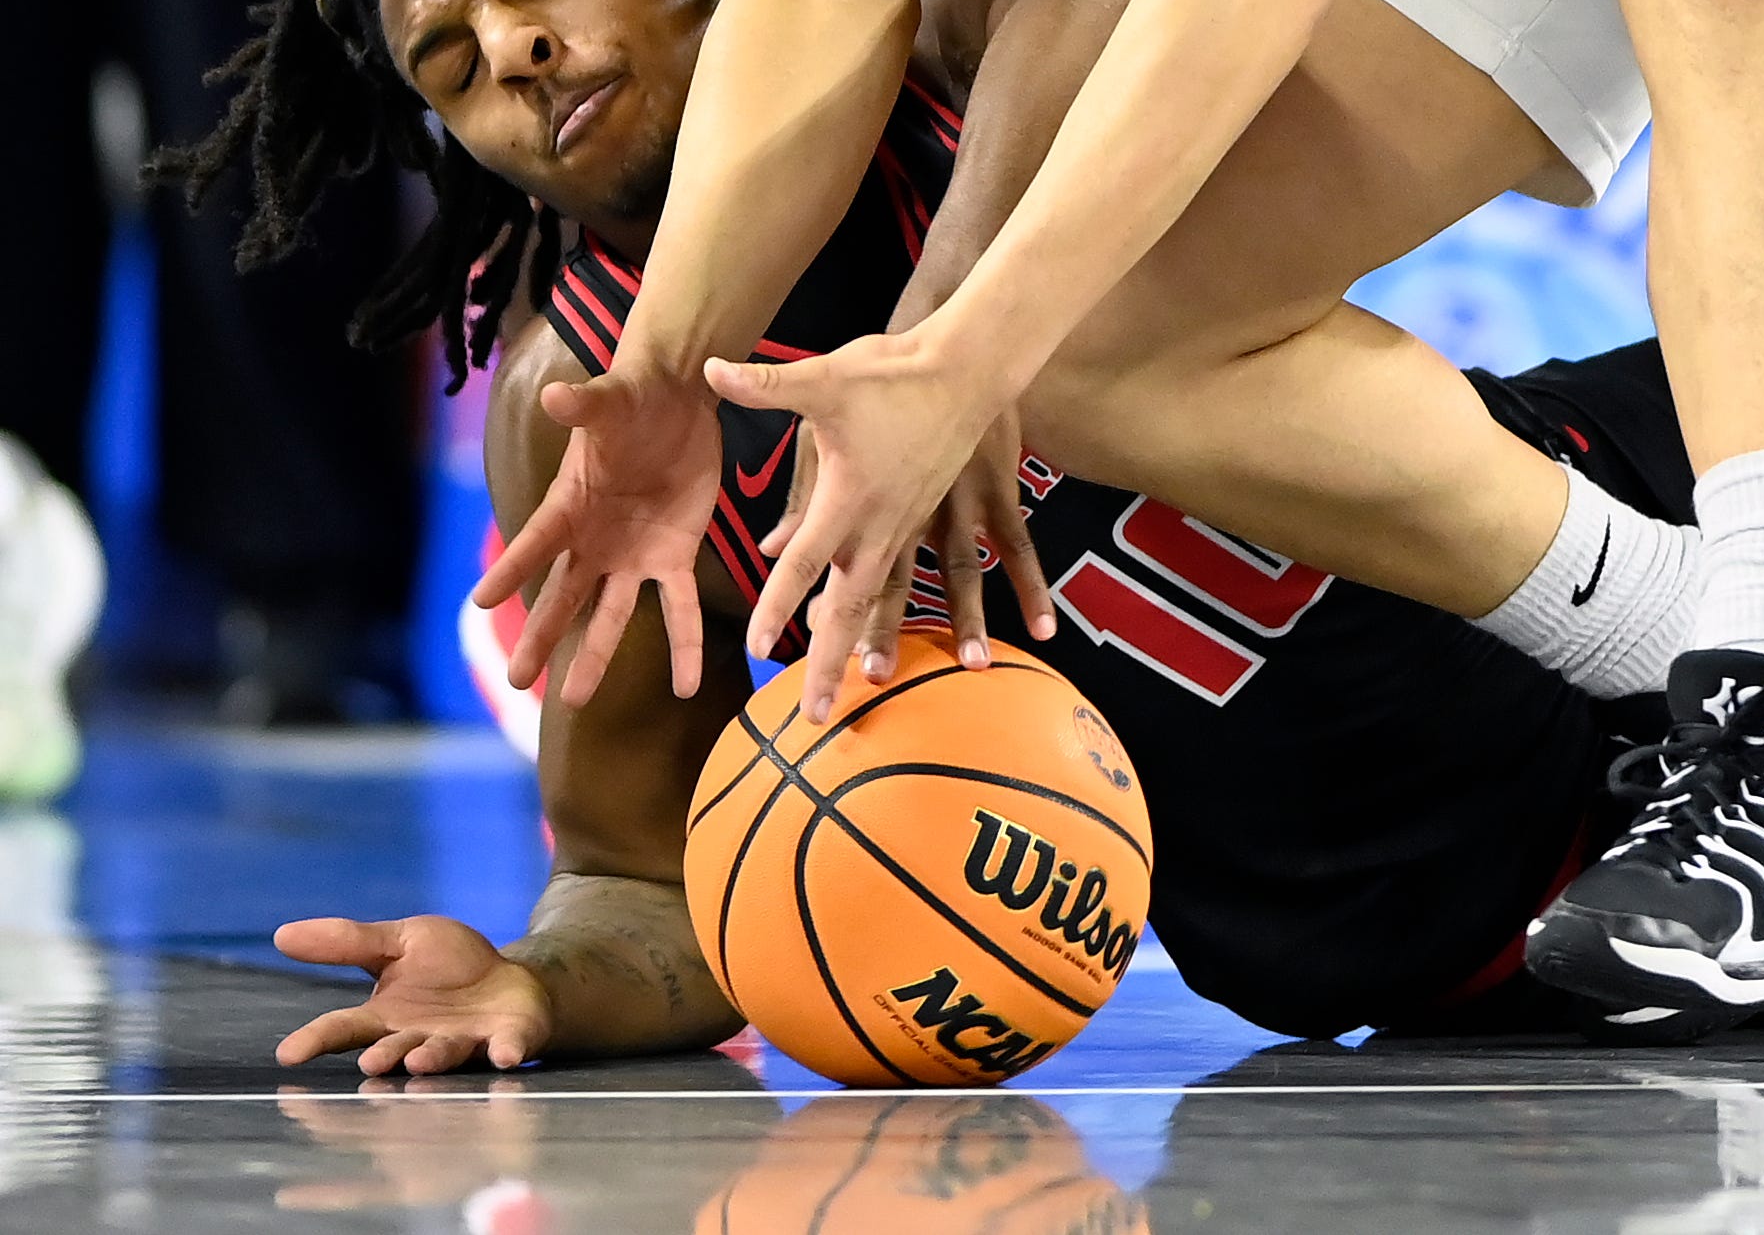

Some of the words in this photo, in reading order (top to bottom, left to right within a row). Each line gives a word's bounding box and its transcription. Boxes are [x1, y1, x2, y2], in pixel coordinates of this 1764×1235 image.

[1050, 492, 1336, 708] 10
[1021, 926, 1062, 955] INDOOR
[873, 993, 931, 1056] OFFICIAL
